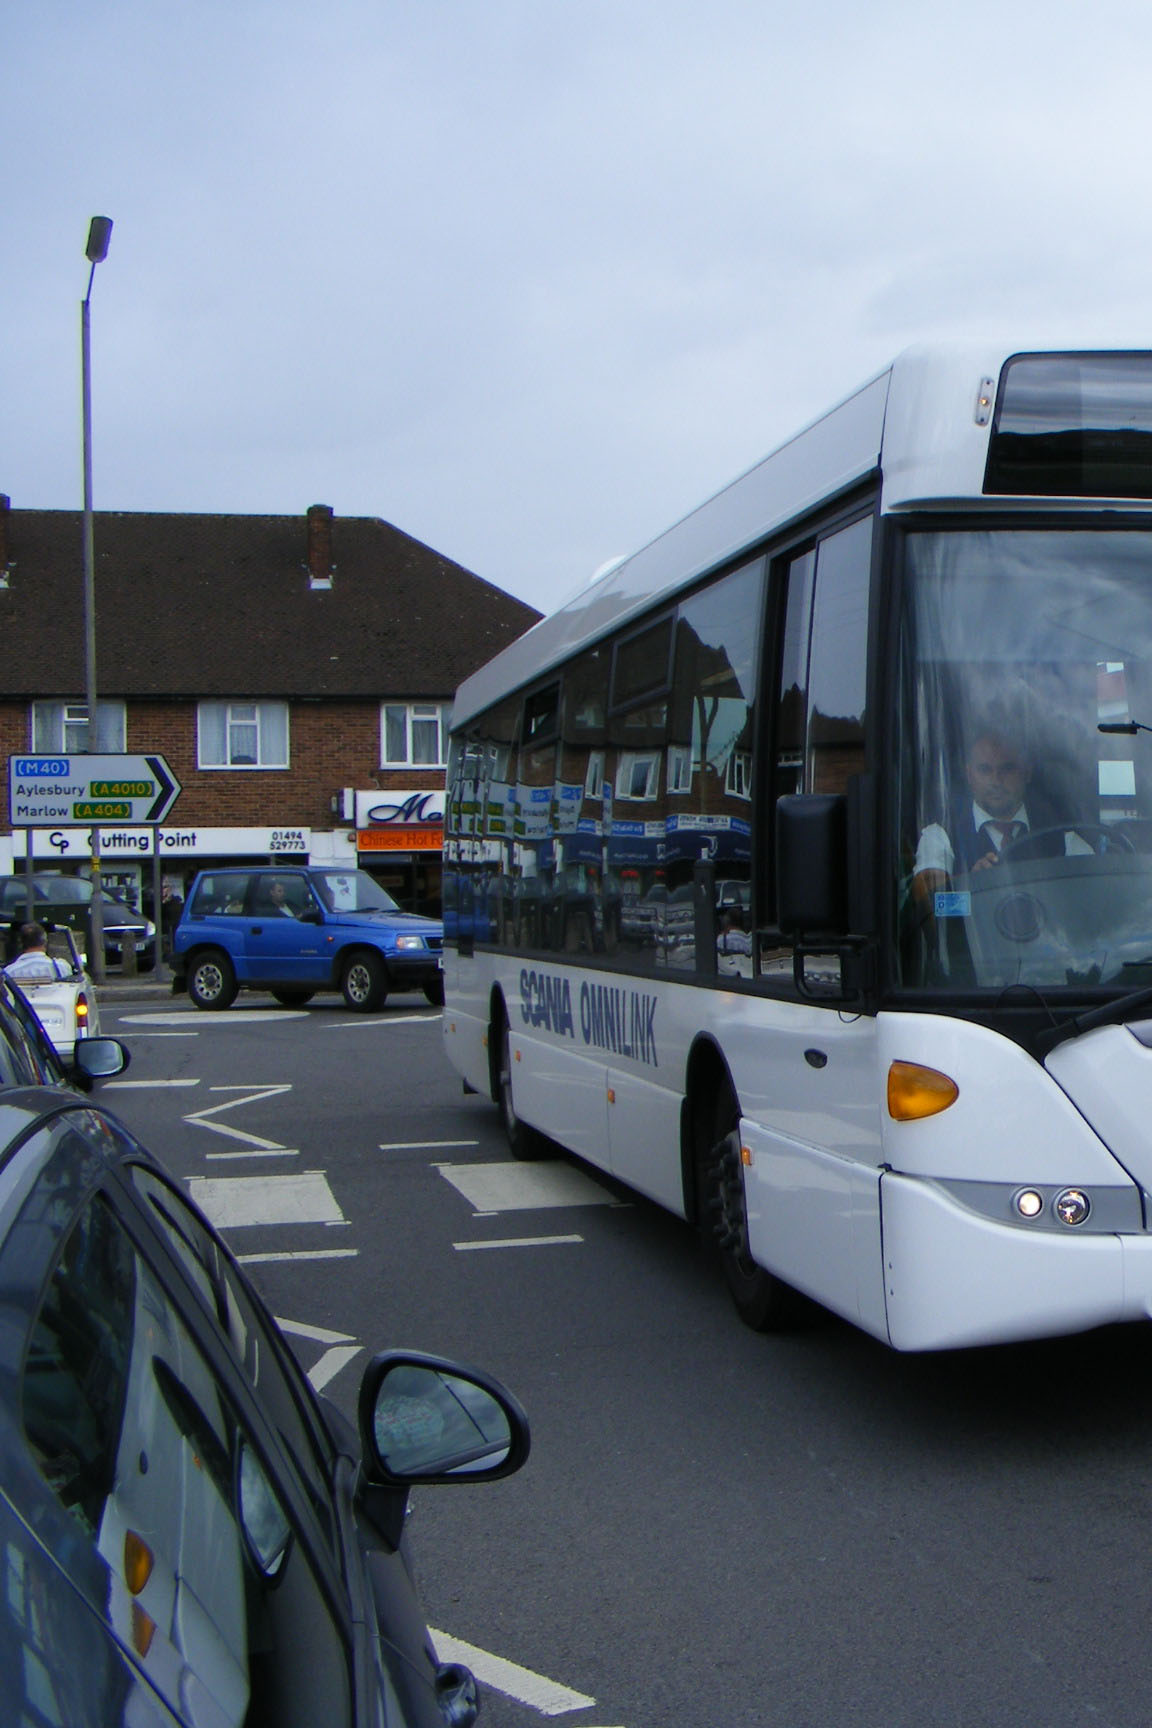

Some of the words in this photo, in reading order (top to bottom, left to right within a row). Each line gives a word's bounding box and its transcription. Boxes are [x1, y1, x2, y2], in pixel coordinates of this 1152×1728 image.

[17, 760, 68, 776] (M40)
[16, 784, 85, 797] Aylesbury
[91, 782, 153, 797] (A4010)
[17, 806, 69, 817] Marlow
[75, 803, 131, 817] (A404)
[272, 832, 302, 841] 01494
[269, 841, 306, 850] 529773
[520, 968, 575, 1039] SCANIA
[580, 980, 658, 1067] OMNILINK
